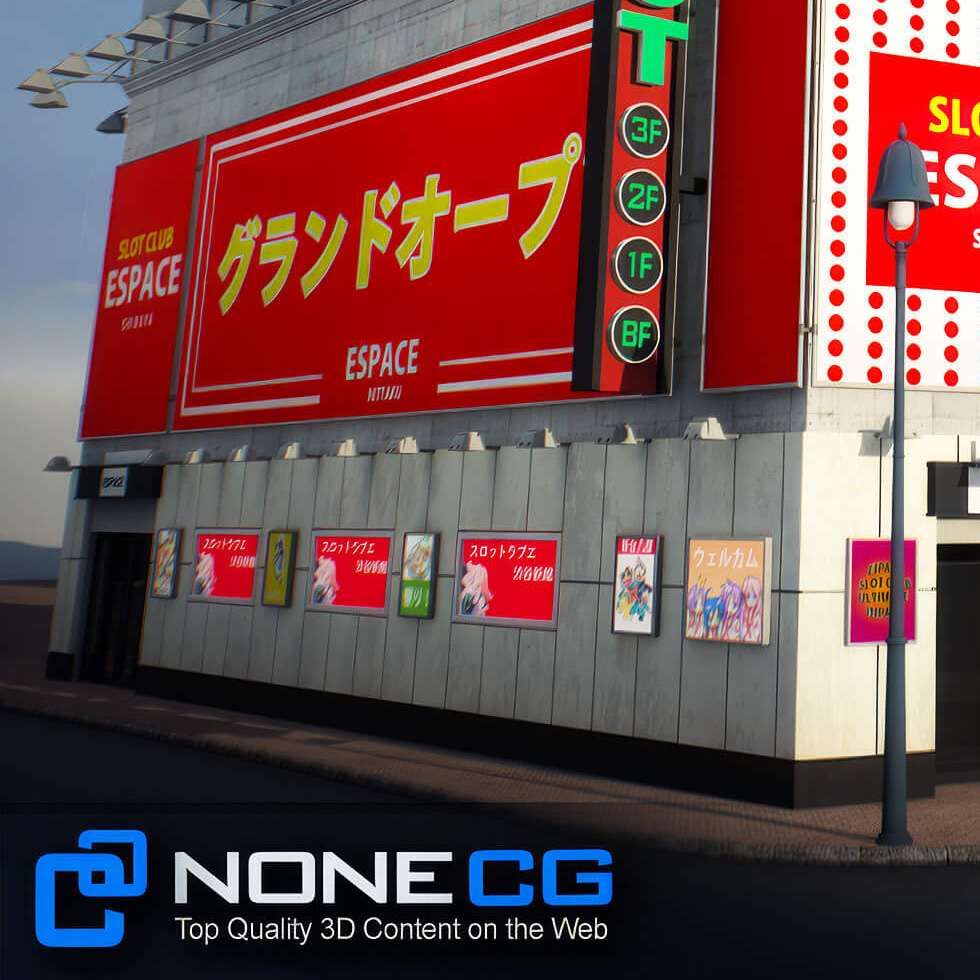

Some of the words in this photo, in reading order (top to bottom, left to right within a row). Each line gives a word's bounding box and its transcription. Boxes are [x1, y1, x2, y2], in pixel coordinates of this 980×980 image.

[631, 116, 662, 143] 3F
[628, 183, 658, 210] 2F
[217, 132, 582, 316] グランドオープ
[628, 251, 653, 279] 1F
[104, 253, 182, 308] ESPACE
[622, 320, 651, 348] BF
[345, 338, 420, 381] ESPACE
